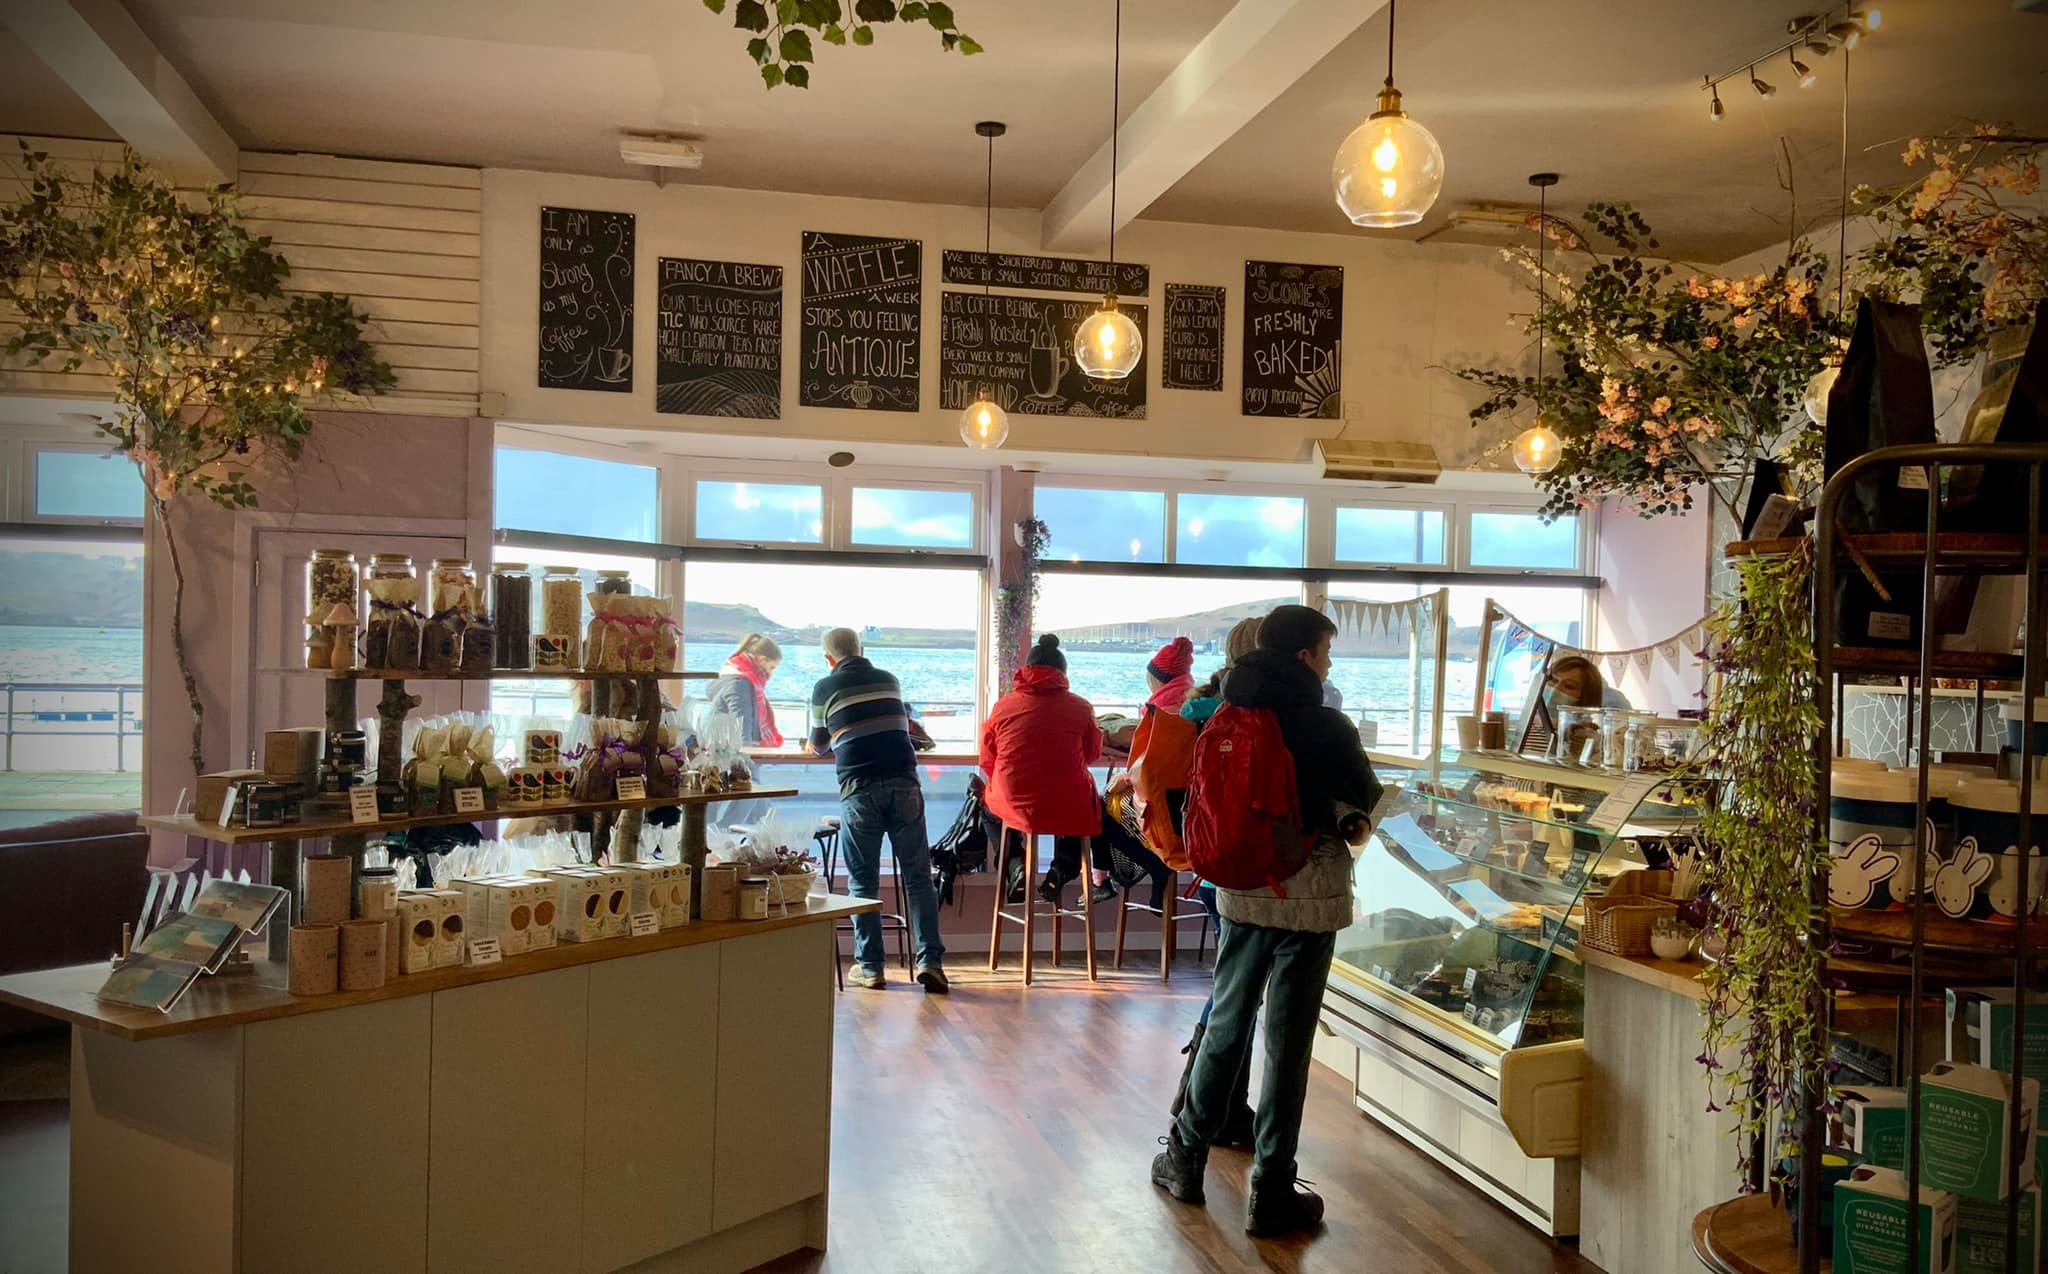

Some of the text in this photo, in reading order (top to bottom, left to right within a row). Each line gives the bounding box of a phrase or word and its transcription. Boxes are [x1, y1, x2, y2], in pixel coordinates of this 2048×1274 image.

[544, 211, 590, 236] I AM
[544, 237, 594, 254] ONLY as
[809, 233, 833, 250] A
[665, 261, 782, 287] FANCY A BREW?
[805, 245, 913, 294] WAFFLE
[946, 252, 1119, 276] WE USE SHORTBREAD AND TABLET
[542, 262, 594, 293] Strong
[949, 266, 975, 280] MADE
[981, 268, 993, 281] BY
[996, 269, 1024, 284] SMALL
[1030, 272, 1071, 288] SCOTTISH
[543, 292, 579, 316] as my
[661, 293, 781, 317] OUR TEA COMES FROM
[868, 292, 920, 304] A WEEK
[1252, 278, 1330, 308] SCONES
[943, 295, 1039, 320] OUR COFFEE BEANS
[1175, 298, 1214, 313] OUR JAM
[1312, 308, 1334, 320] ARE
[660, 311, 781, 336] TLC WHO SOURCE RARE
[806, 307, 918, 333] STOPS YOU FEELING
[989, 317, 1029, 346] Roasted
[1172, 315, 1218, 329] AND LEMON
[1254, 310, 1318, 337] FRESHLY
[540, 326, 589, 352] Coffee
[659, 329, 781, 354] HIGH ELEVATION TEAS FROM
[1172, 331, 1209, 345] CURD IS
[724, 352, 778, 371] PLANTATIONS
[809, 330, 920, 379] ANTIQUE
[943, 347, 1030, 364] EVERY WEEK BY SMALL
[1172, 347, 1217, 362] HOMEMADE
[1253, 338, 1328, 376] BAKED
[951, 362, 1026, 380] SCOTTISH COMPANY
[1018, 400, 1066, 415] COFFEE
